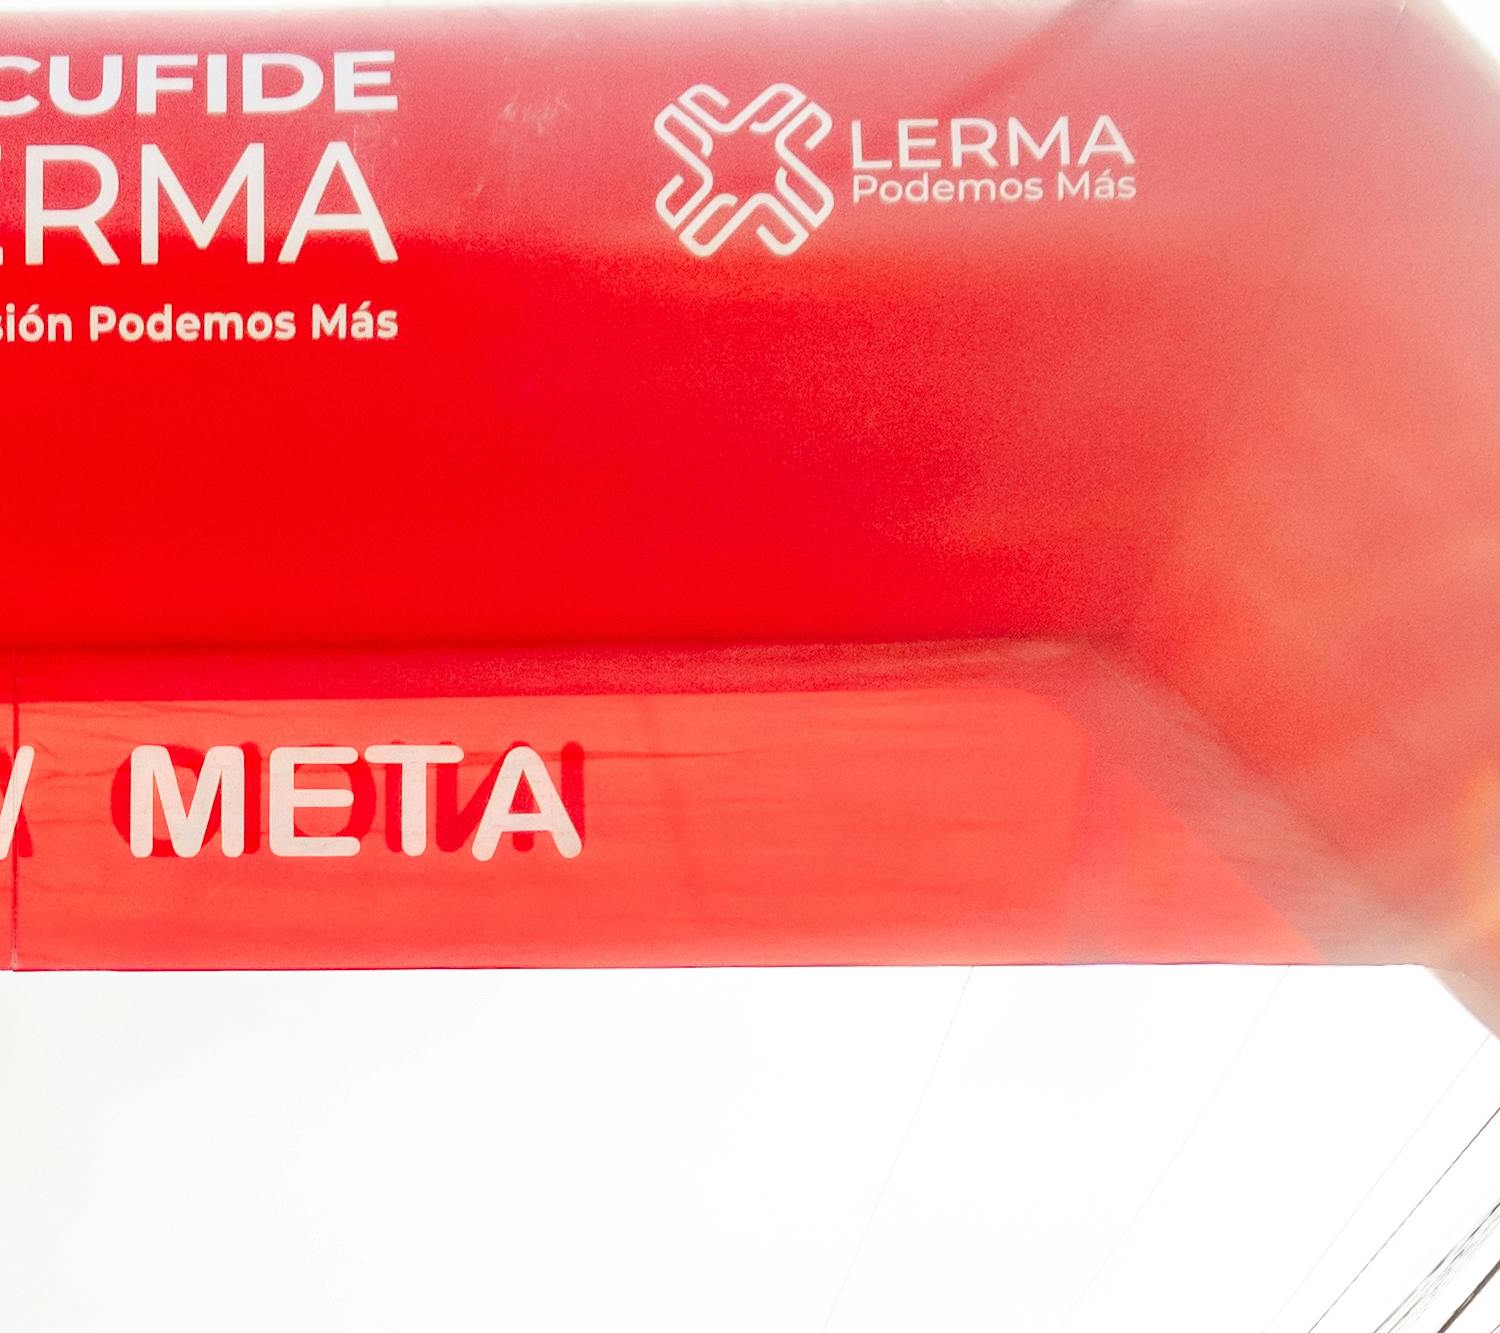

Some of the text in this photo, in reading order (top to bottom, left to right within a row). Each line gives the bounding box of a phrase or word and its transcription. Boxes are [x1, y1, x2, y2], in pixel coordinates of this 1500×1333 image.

[850, 114, 1136, 170] LERMA
[853, 169, 1137, 203] Podemos Más
[89, 303, 296, 341] Podemos
[311, 300, 399, 341] Más
[128, 743, 585, 862] META
